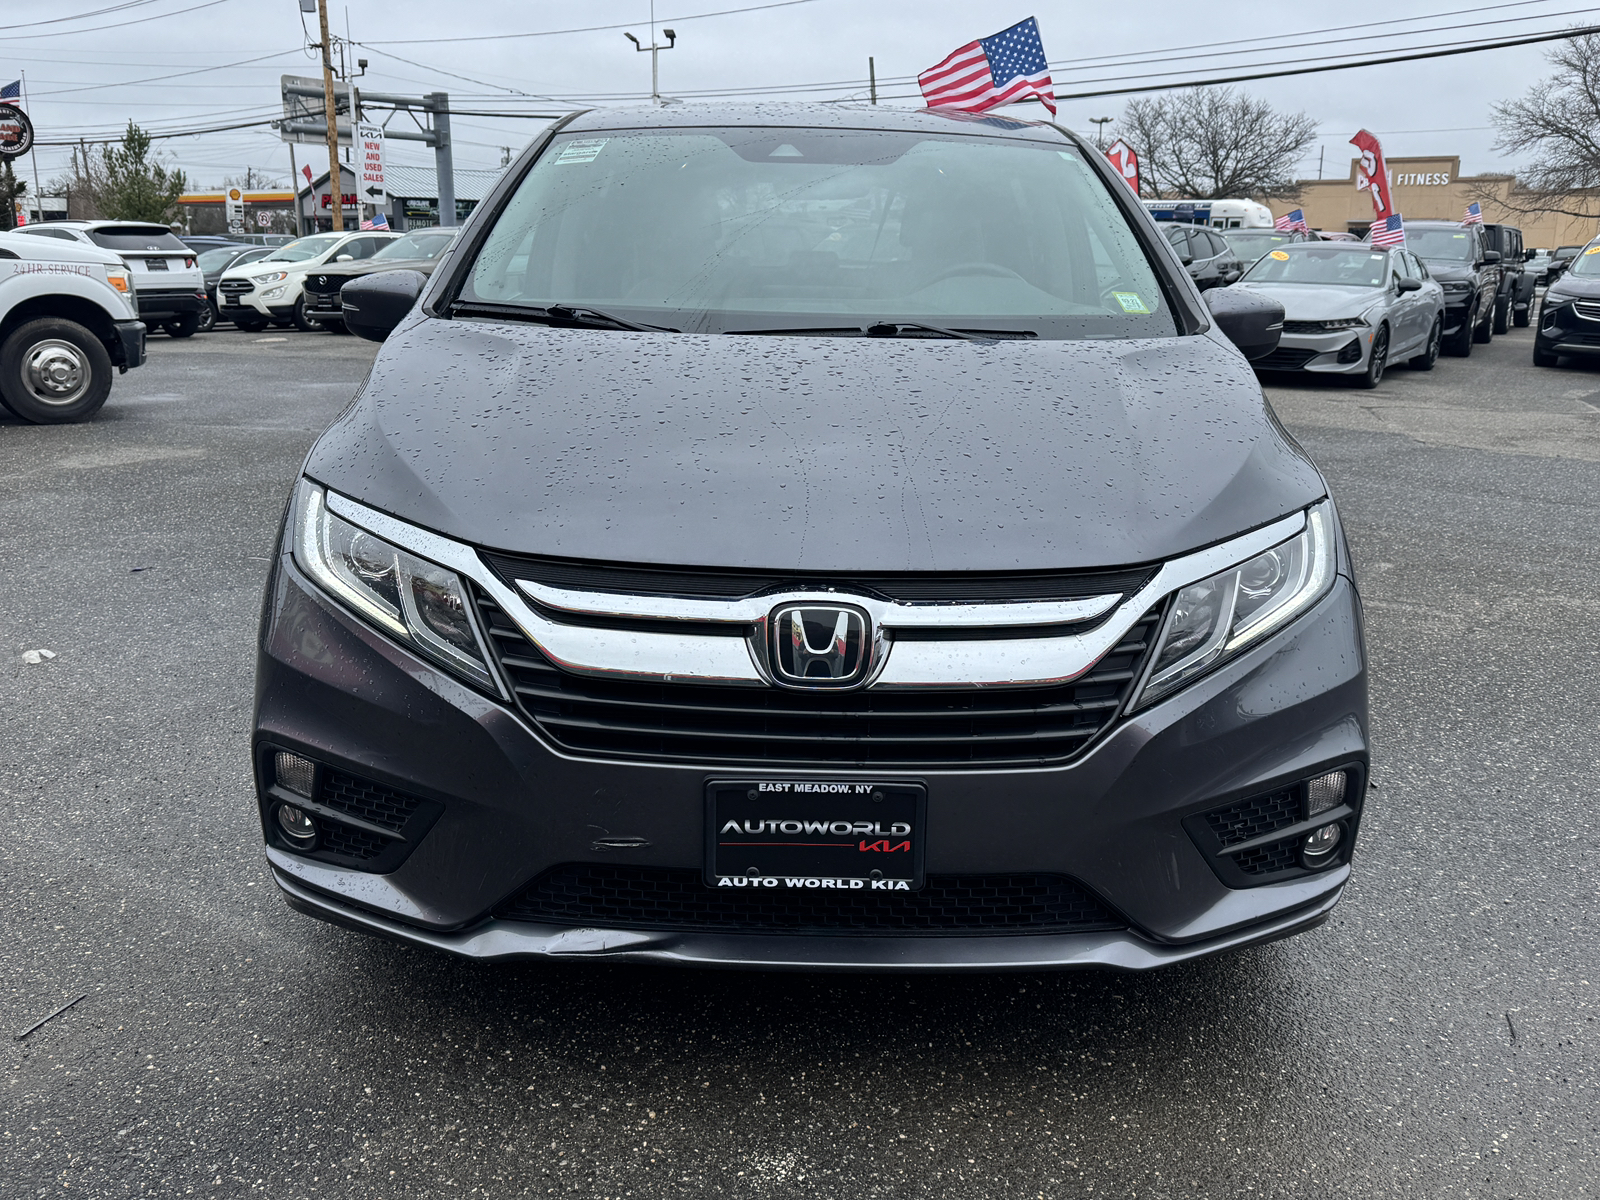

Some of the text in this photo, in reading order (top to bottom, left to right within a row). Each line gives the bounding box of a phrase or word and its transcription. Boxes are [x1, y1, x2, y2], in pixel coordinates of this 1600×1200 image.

[364, 141, 380, 150] NEW
[366, 152, 380, 161] AND
[364, 163, 382, 172] USED
[363, 173, 384, 182] SALES
[1397, 173, 1449, 185] FITNESS
[48, 263, 91, 277] SERVICE
[759, 783, 790, 792] EAST
[855, 785, 873, 794] NY
[719, 819, 911, 836] AUTOWORLD
[859, 840, 911, 852] KIA
[717, 877, 911, 890] AUTO WORLD KIA
